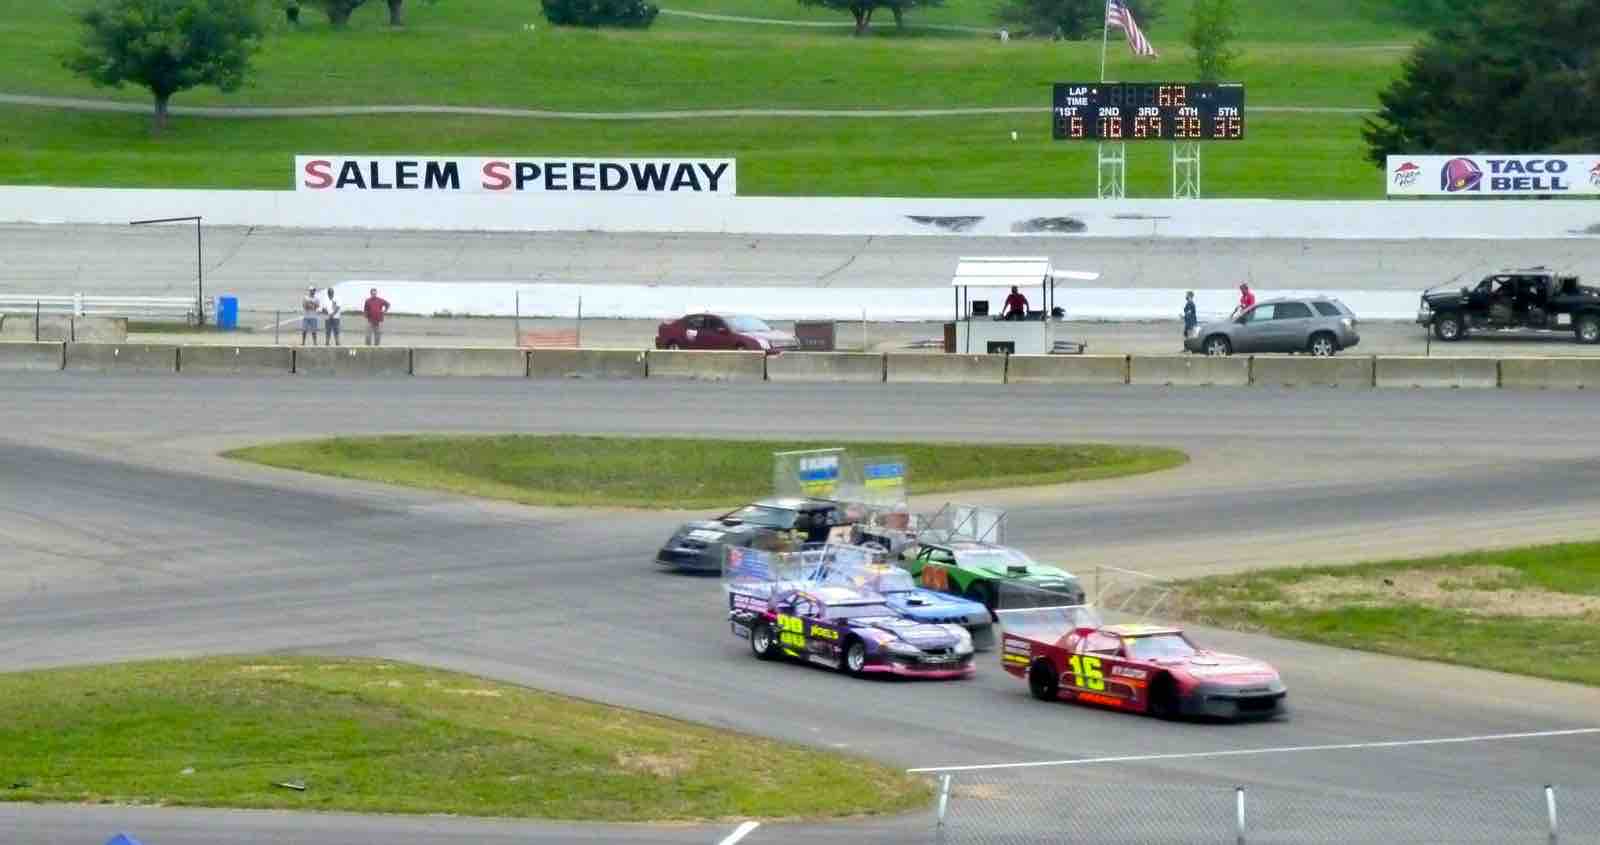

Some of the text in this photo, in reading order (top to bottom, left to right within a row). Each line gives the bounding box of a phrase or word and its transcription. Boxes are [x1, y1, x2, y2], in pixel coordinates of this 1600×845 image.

[1069, 87, 1088, 96] LAP
[1066, 97, 1089, 106] TIME
[1059, 107, 1238, 117] 1ST 2ND 3RD 4TH 5TH
[1213, 117, 1241, 137] 35
[1486, 159, 1569, 174] TACO
[303, 159, 729, 192] SALEM SPEEDWAY
[1491, 176, 1569, 191] BELL
